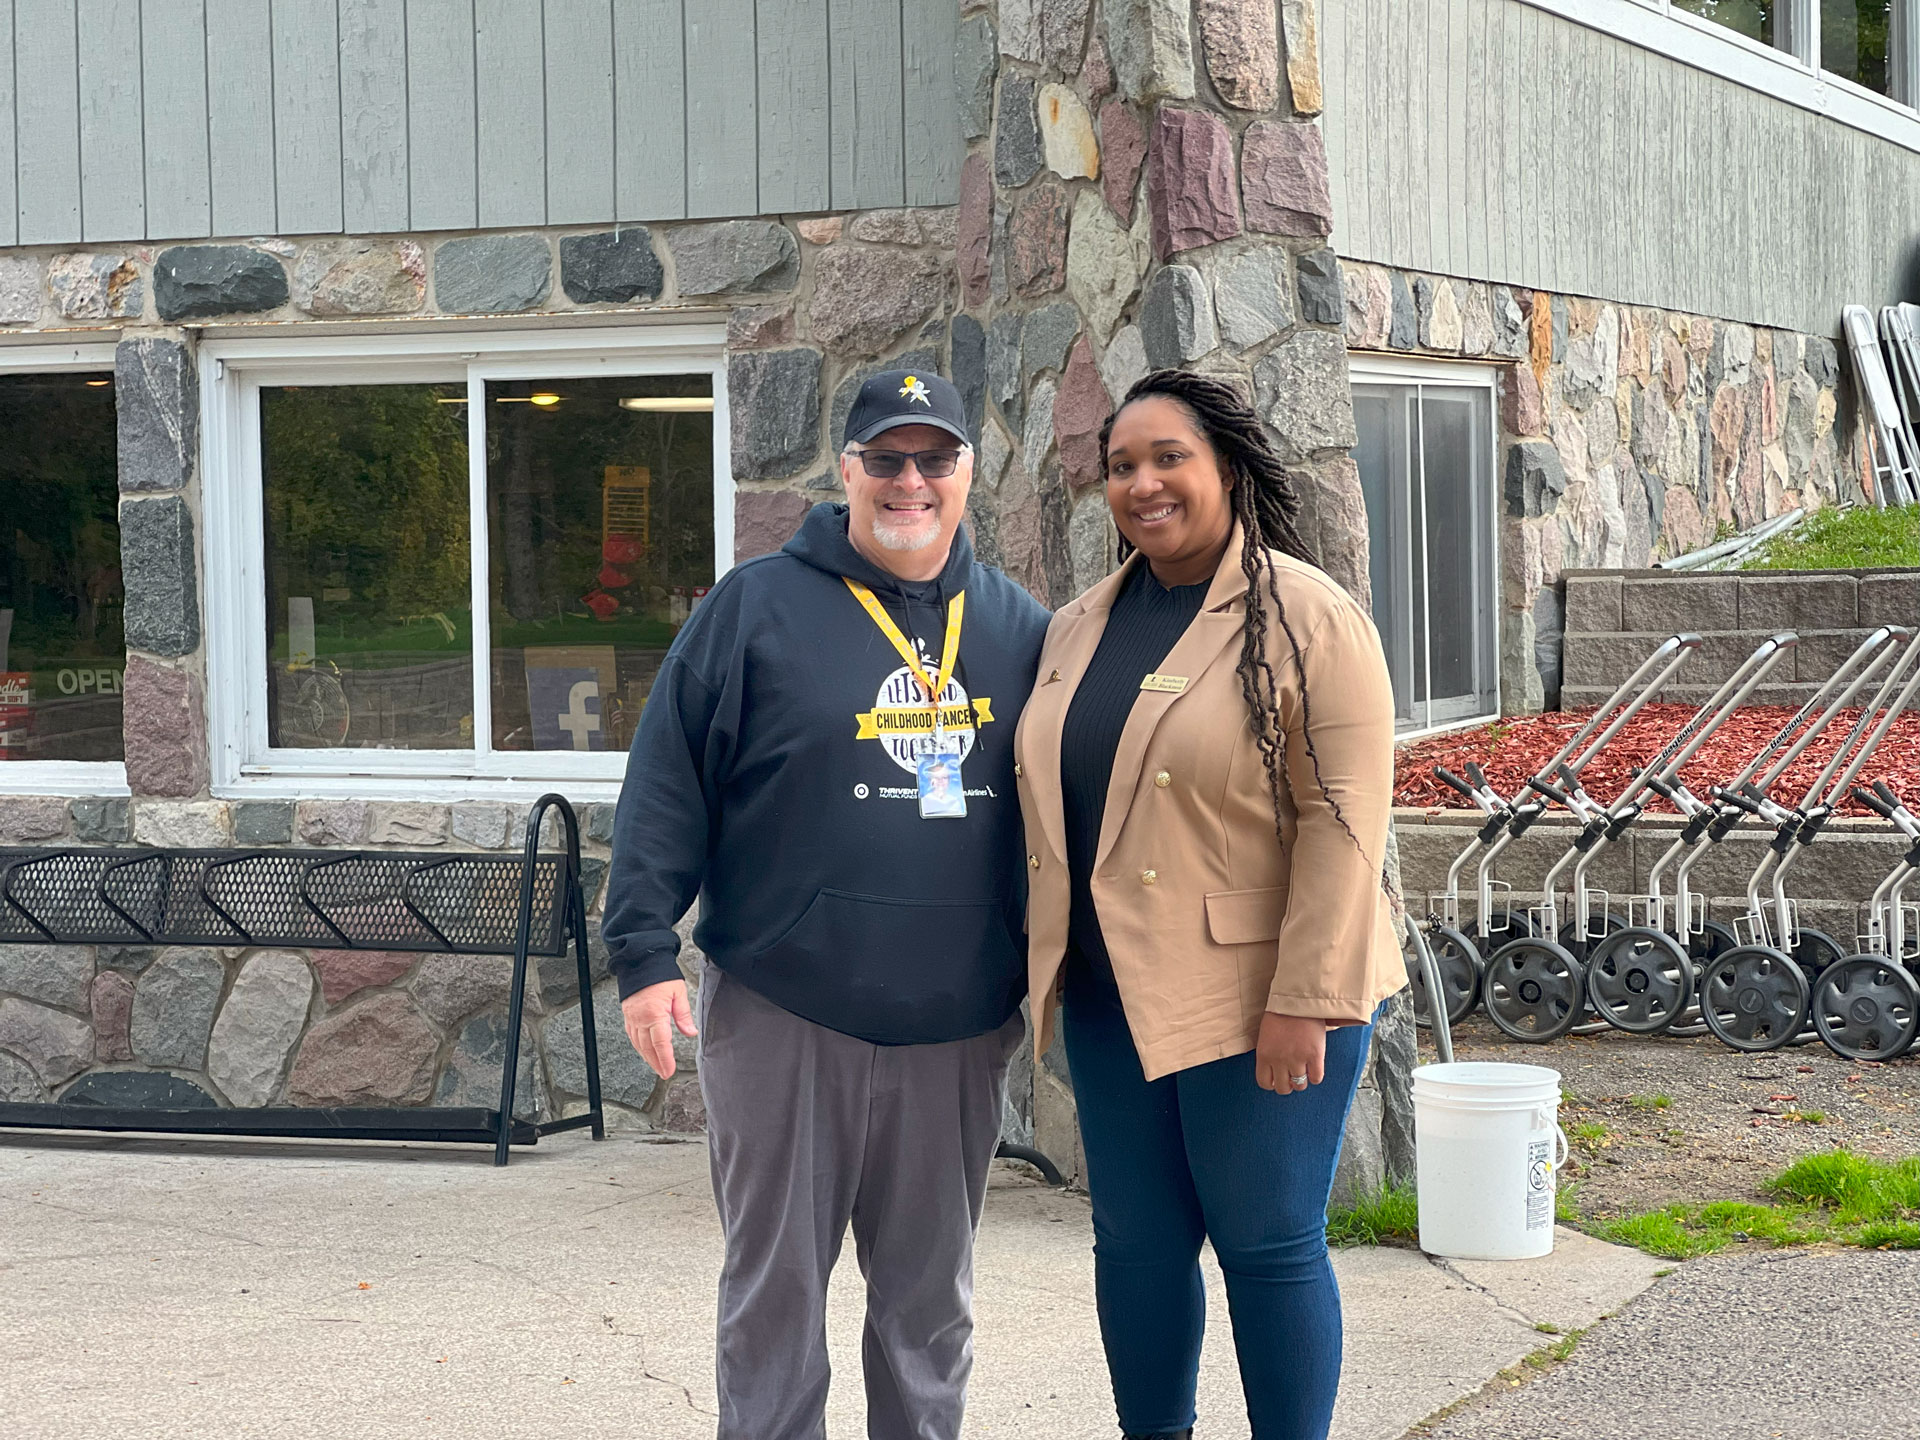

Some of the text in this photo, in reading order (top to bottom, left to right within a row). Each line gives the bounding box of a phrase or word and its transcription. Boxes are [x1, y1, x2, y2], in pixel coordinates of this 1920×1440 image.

[876, 713, 933, 729] CHILDHOOD
[879, 787, 918, 795] THRIVENT
[968, 789, 988, 797] Airlines
